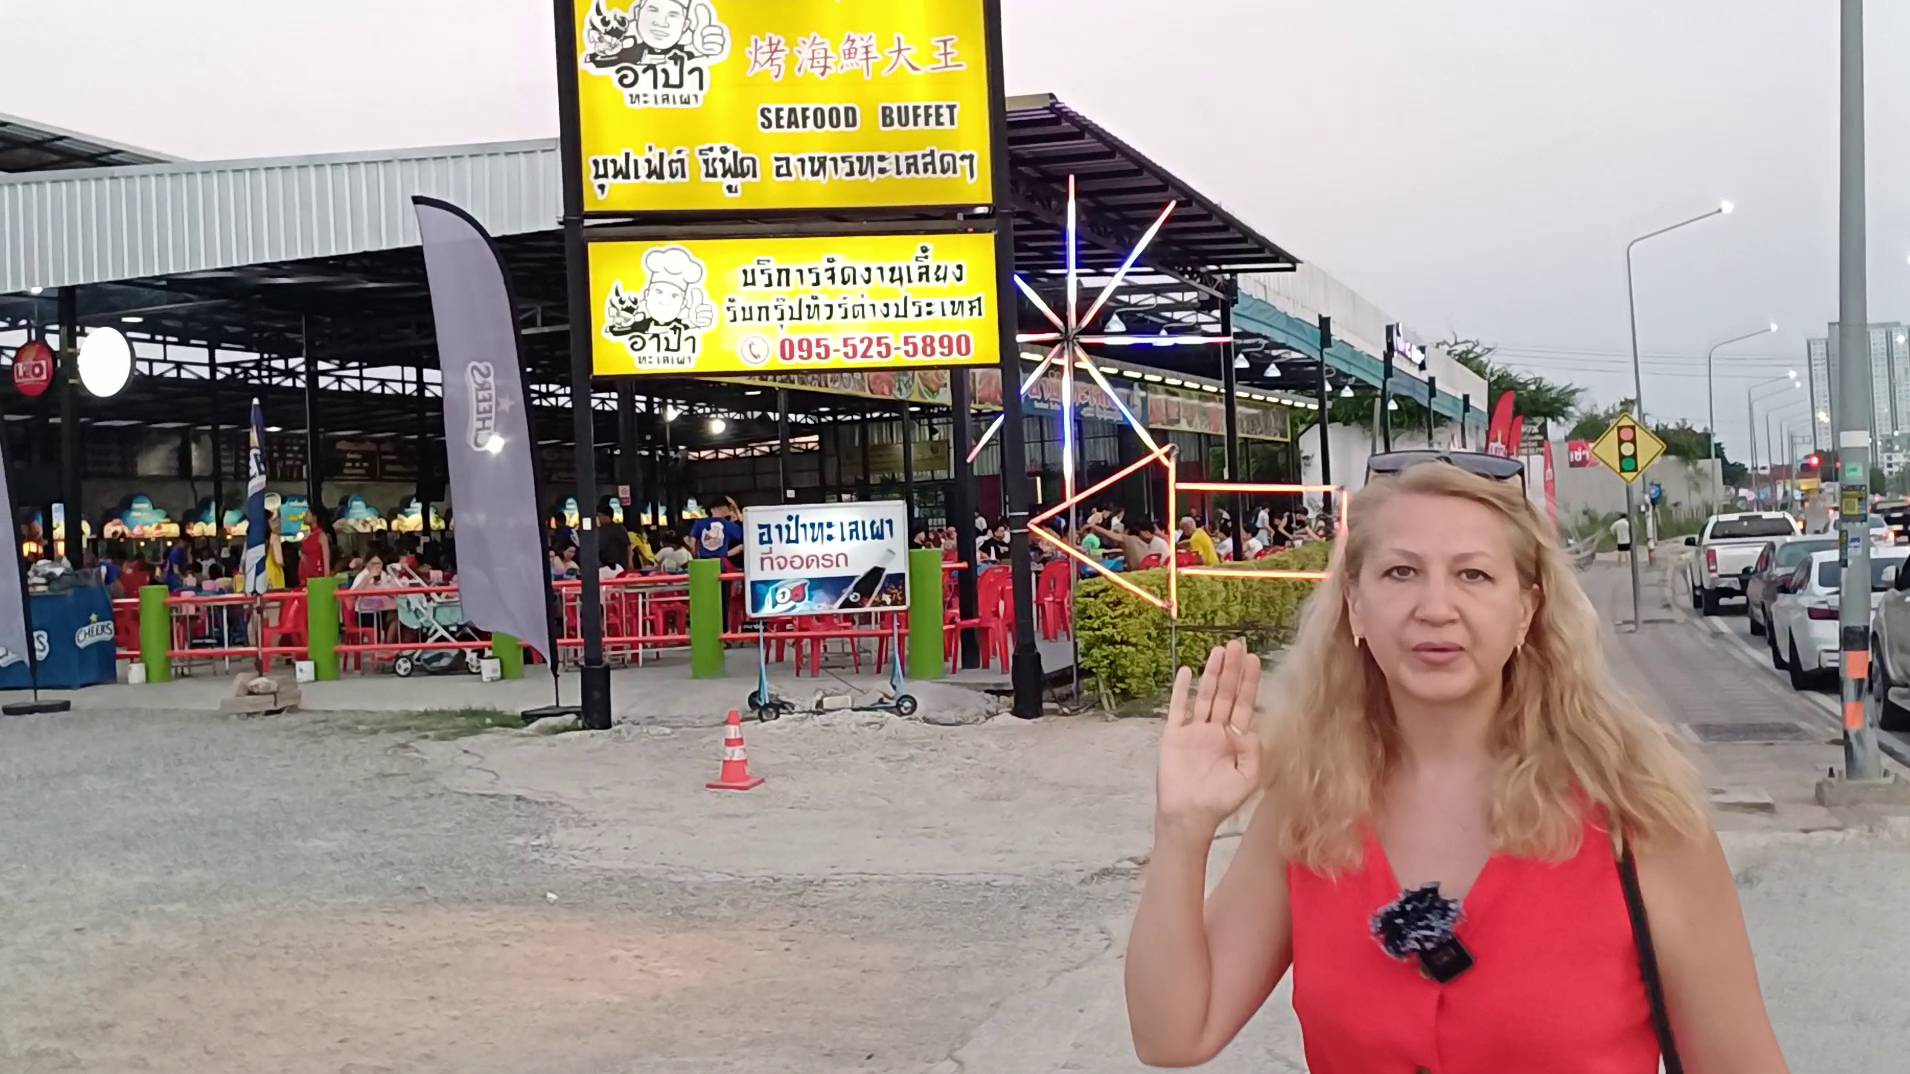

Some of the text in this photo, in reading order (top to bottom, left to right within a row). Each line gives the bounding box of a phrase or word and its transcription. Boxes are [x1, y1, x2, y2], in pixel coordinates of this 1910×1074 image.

[748, 33, 965, 79] 烤海鮮大王
[614, 52, 704, 91] อาป๋า
[628, 93, 698, 105] ทะเลเผา
[759, 103, 958, 130] SEAFOOD BUFFET
[592, 145, 976, 195] บุฟเฟ่ต์ ซีฟู้ด อาหารทะเลสดๆ
[741, 245, 964, 288] บริการจัดงานเลี้ยง
[726, 294, 983, 329] รับกรุ๊ปทัวร์ต่างประเทศ
[628, 324, 696, 354] อาป๋า
[779, 333, 972, 362] 095-525-5890
[638, 356, 692, 365] ทะเลเผา
[760, 546, 849, 572] ที่จอดรถ
[77, 622, 113, 643] CHEERS
